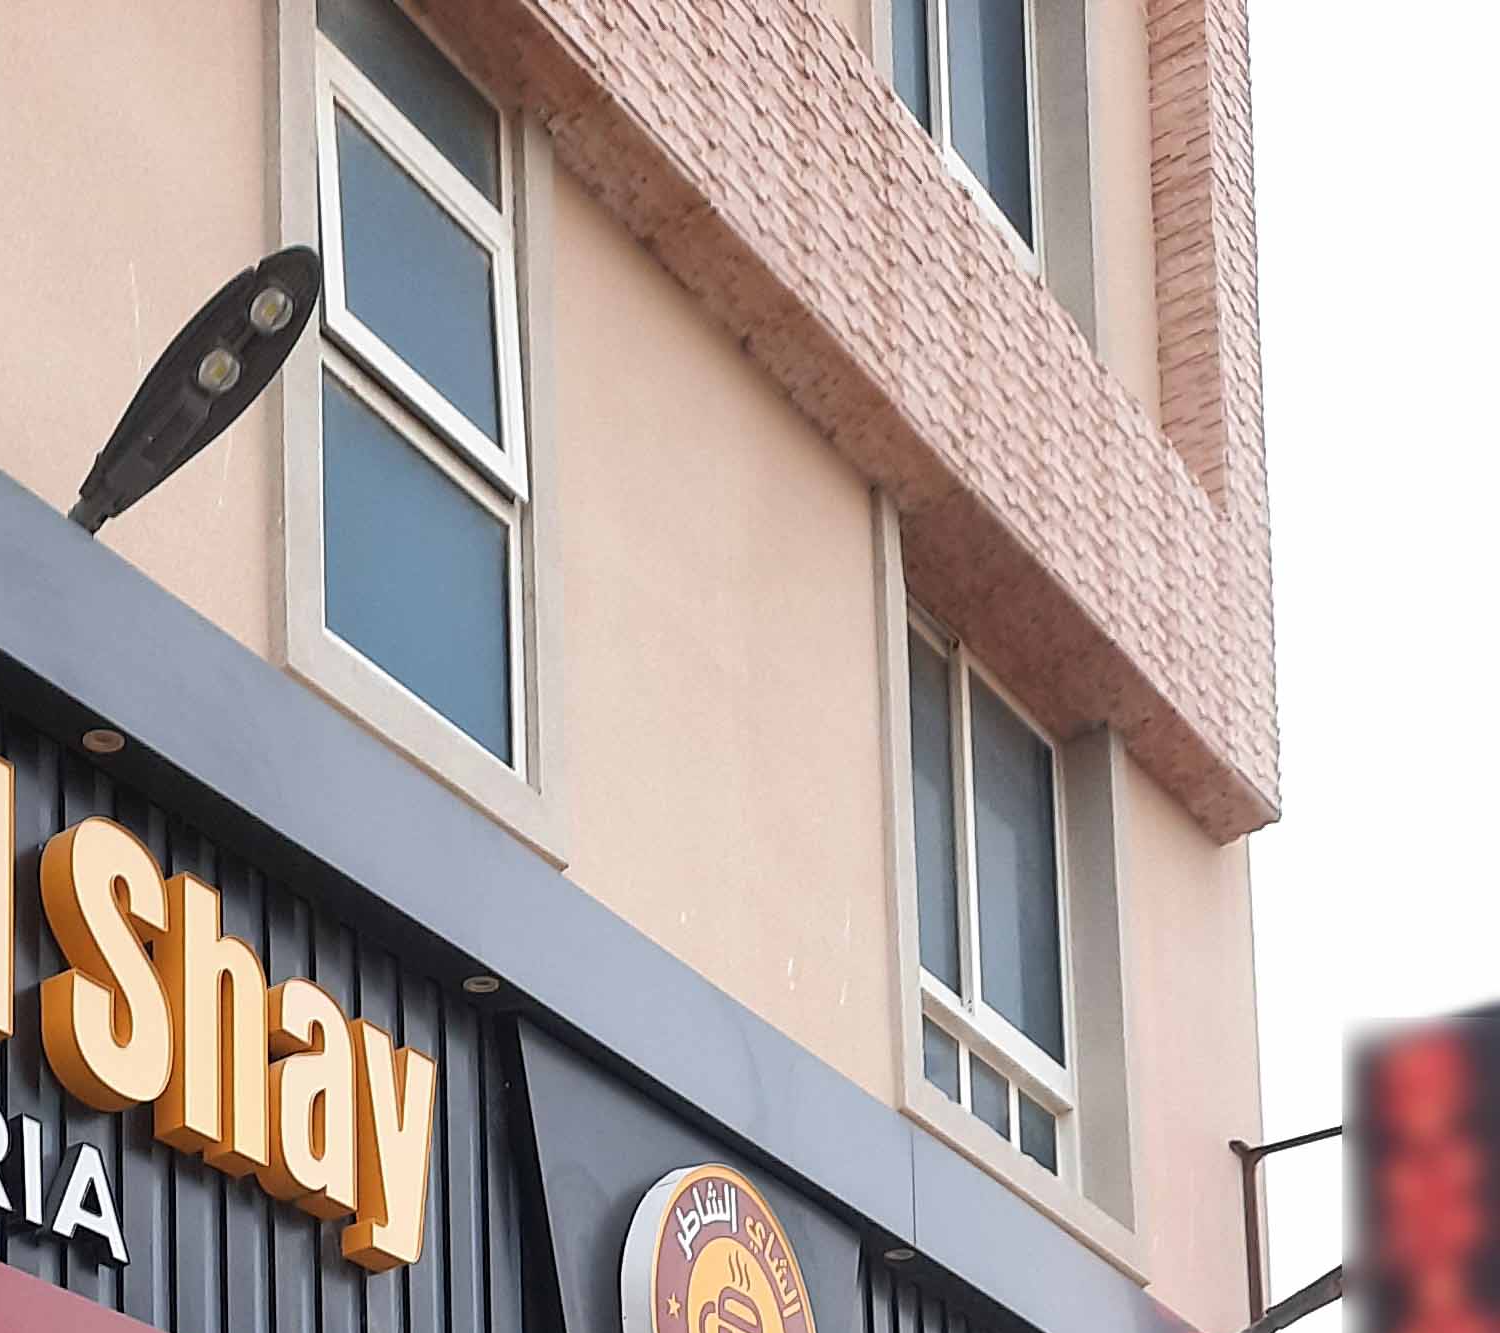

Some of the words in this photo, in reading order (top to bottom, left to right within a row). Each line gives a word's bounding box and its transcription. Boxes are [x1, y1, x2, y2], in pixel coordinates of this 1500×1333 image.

[40, 816, 438, 1273] Shay
[674, 1181, 739, 1260] الشاطر
[744, 1215, 802, 1319] الشاي
